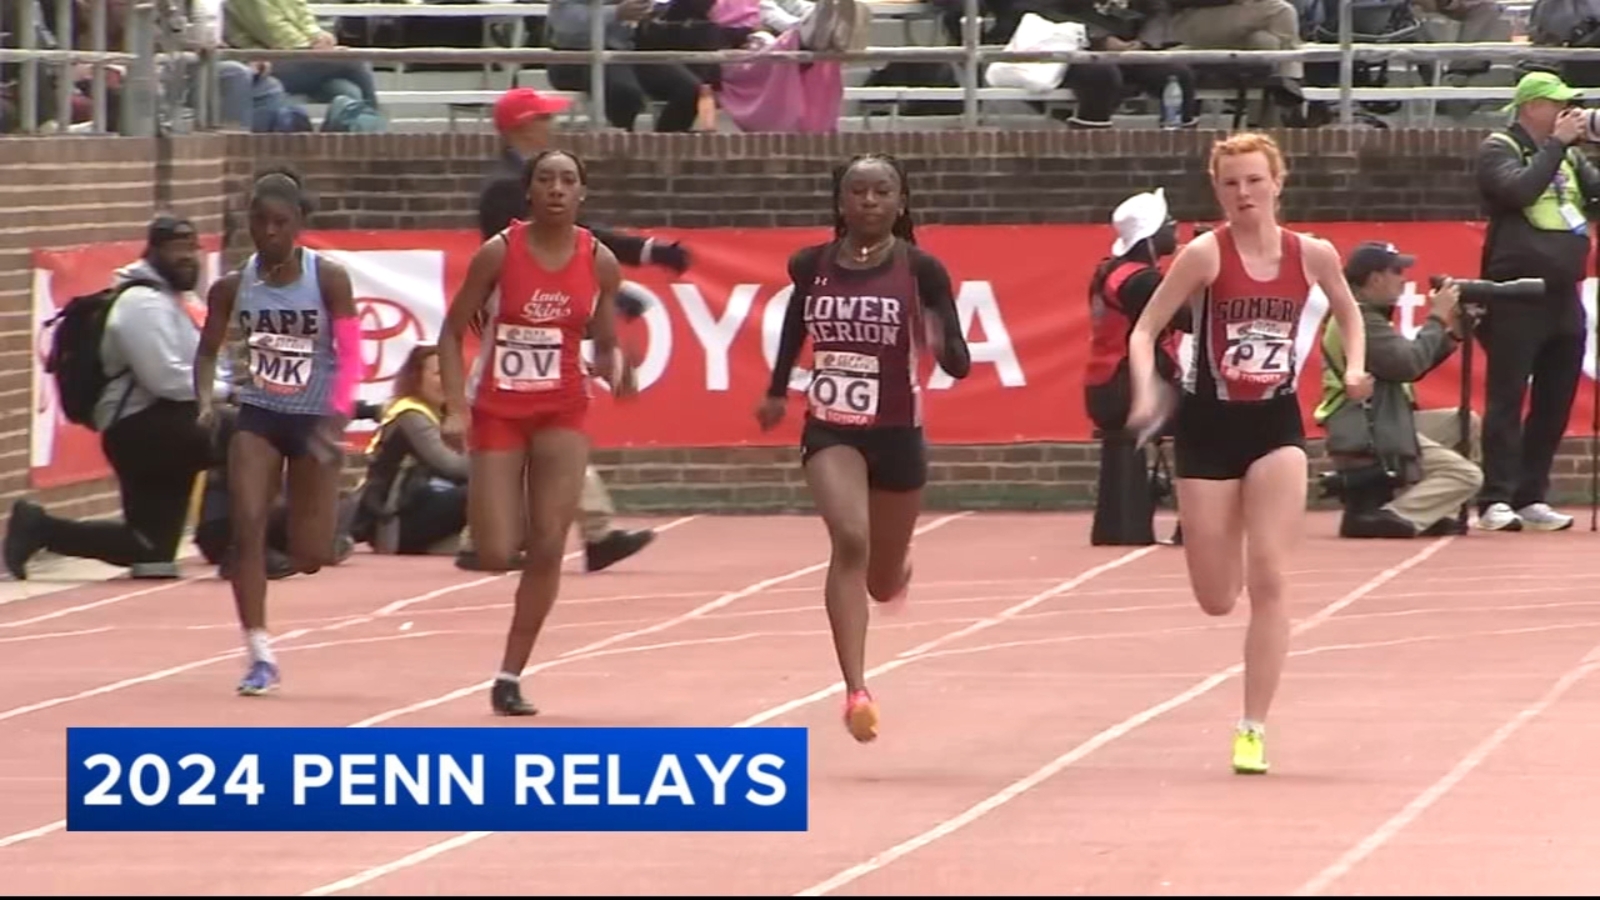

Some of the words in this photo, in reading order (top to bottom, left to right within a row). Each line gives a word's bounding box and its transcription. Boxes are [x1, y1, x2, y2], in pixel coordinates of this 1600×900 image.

[239, 309, 318, 336] CAPE
[803, 296, 901, 325] LOWER
[1216, 298, 1297, 322] SOMER
[255, 353, 306, 384] MK
[500, 350, 555, 377] OV
[1232, 342, 1284, 370] PZ
[813, 376, 871, 411] OG
